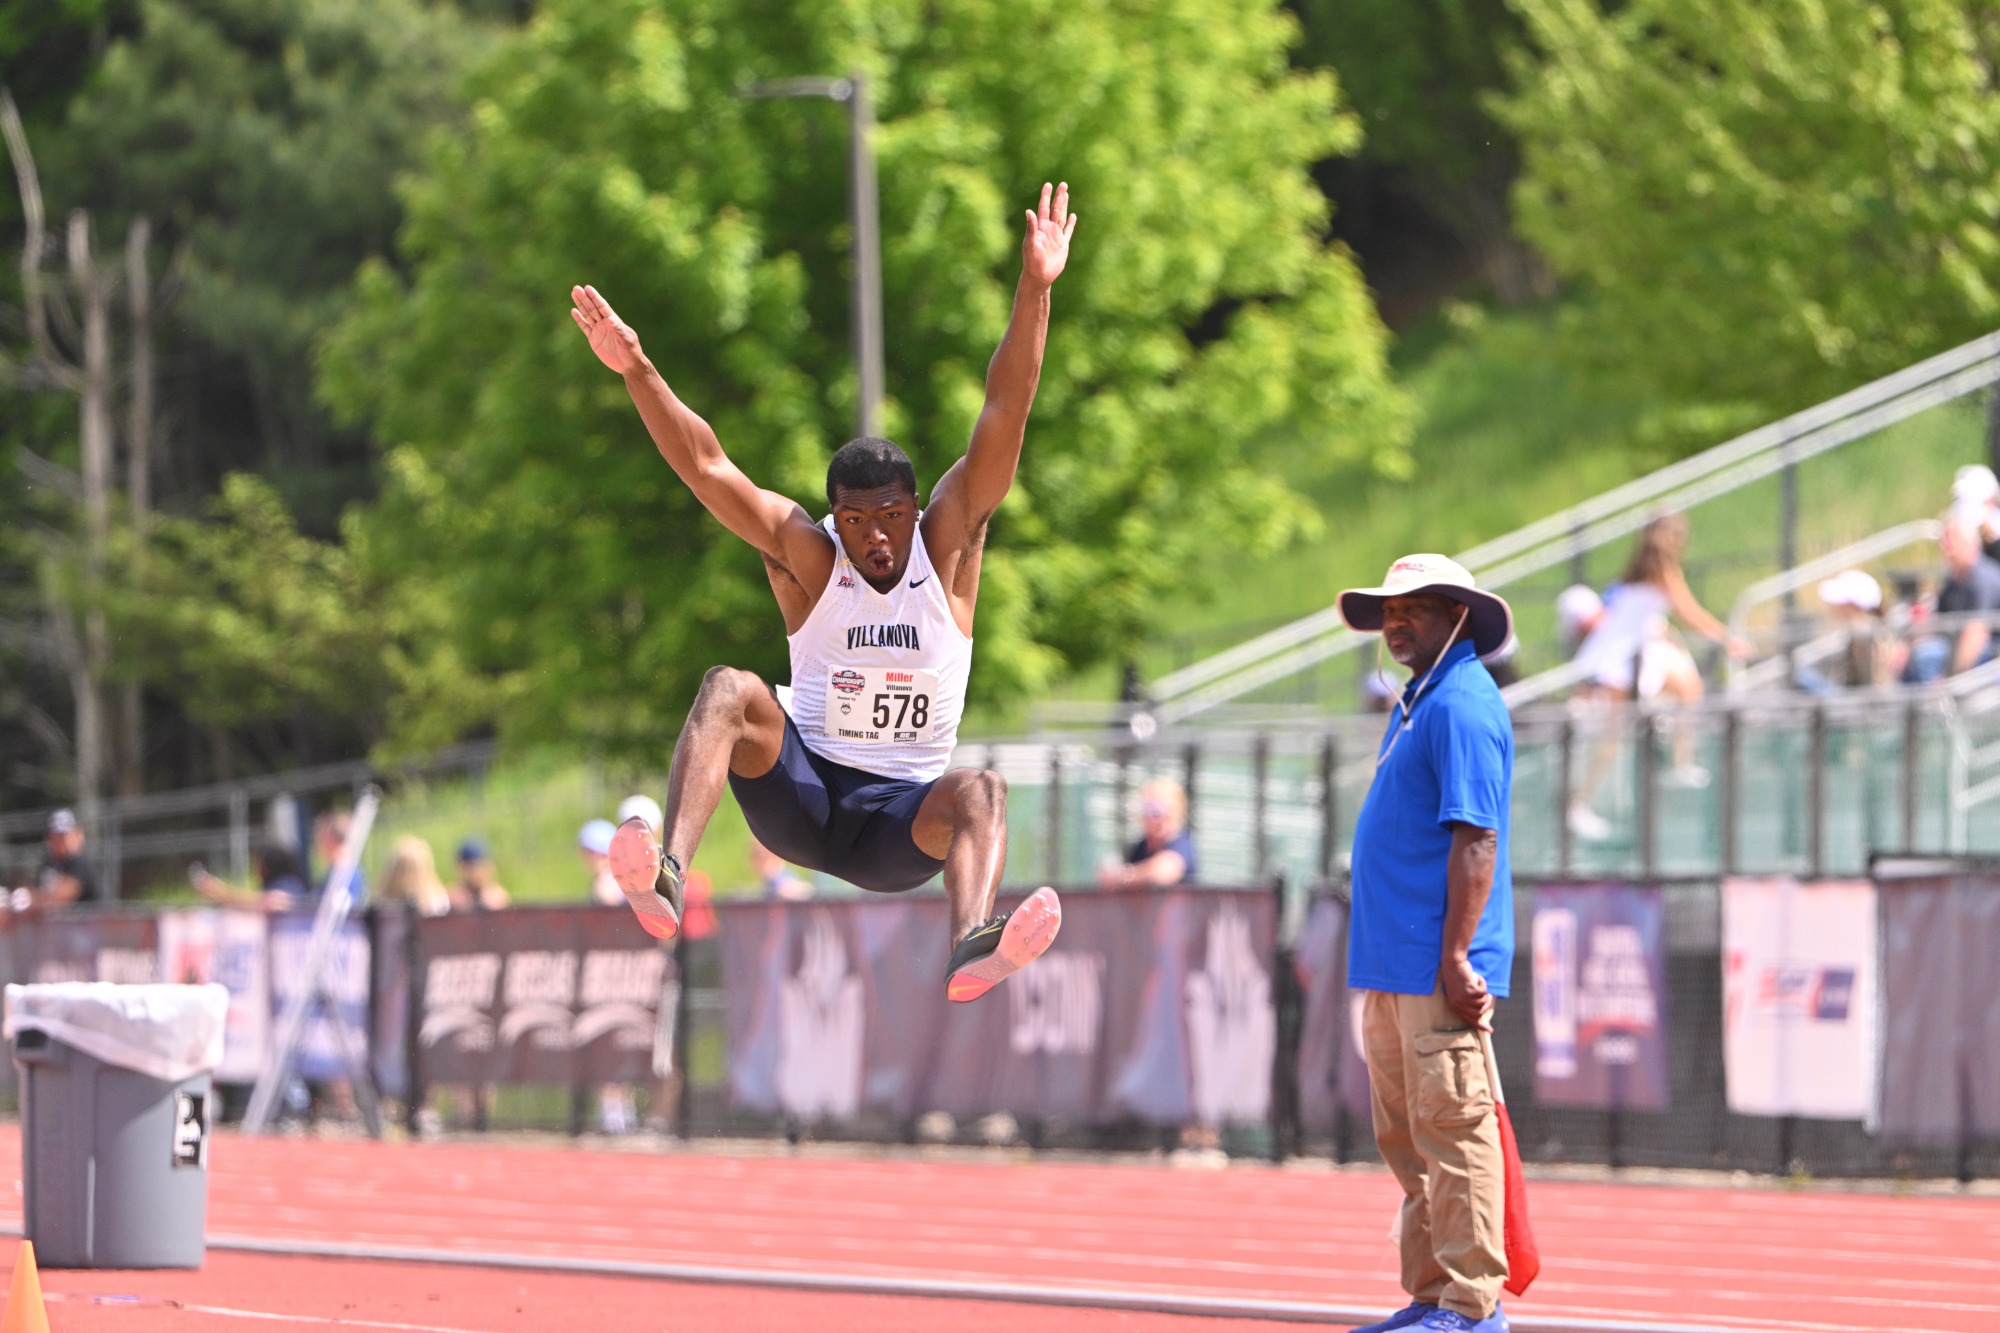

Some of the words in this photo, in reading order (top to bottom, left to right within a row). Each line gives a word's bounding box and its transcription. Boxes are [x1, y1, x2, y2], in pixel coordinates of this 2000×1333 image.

[847, 624, 920, 651] VILLANOVA
[885, 672, 914, 683] Miller
[885, 684, 913, 692] Villanova
[872, 694, 930, 729] 578
[838, 728, 864, 739] TIMING
[866, 731, 879, 740] TAG
